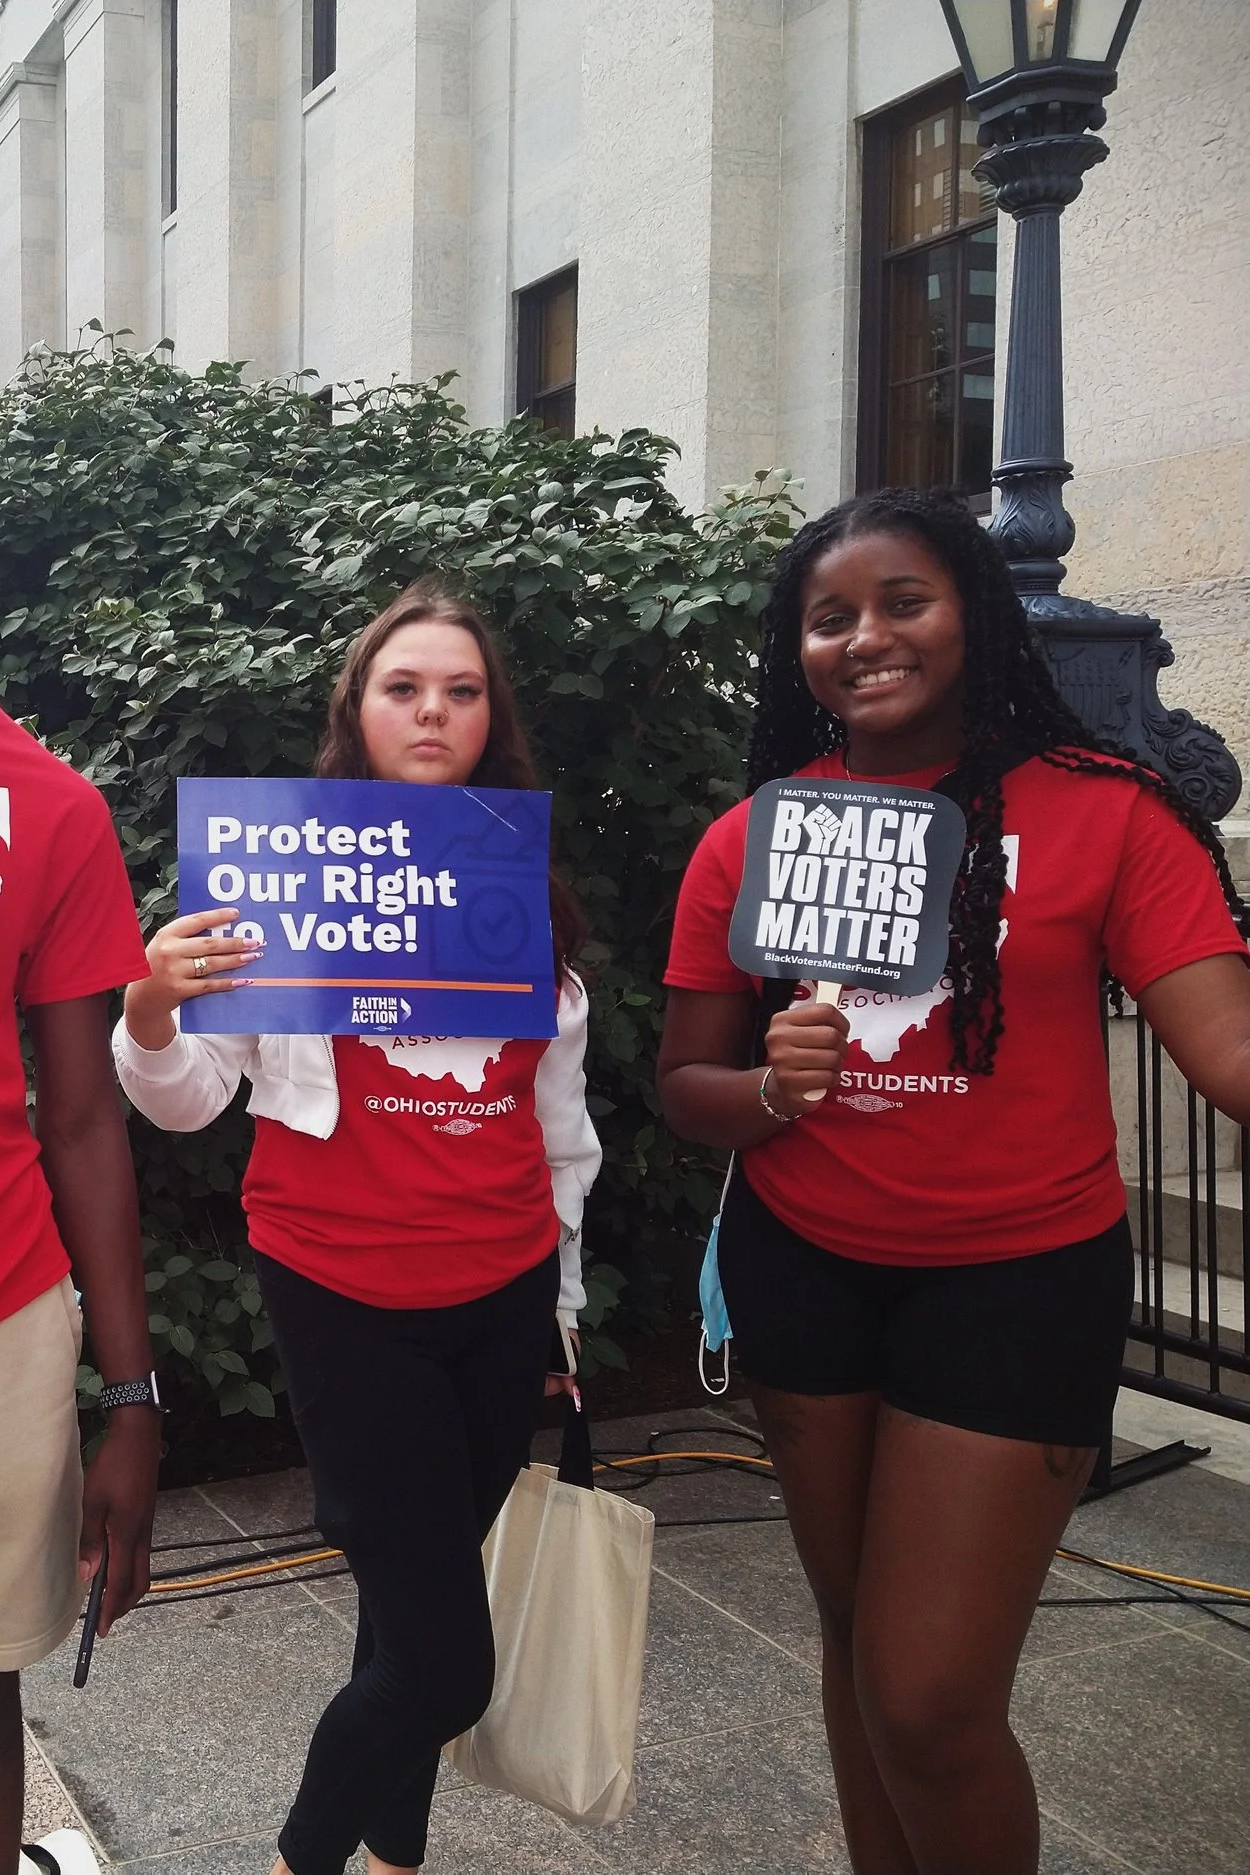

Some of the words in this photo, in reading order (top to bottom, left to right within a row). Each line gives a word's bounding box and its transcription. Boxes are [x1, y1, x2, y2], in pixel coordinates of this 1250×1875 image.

[783, 789, 820, 798] MATTER.
[822, 792, 841, 800] YOU
[843, 794, 880, 804] MATTER.
[883, 797, 897, 805] WE
[898, 799, 936, 810] MATTER.
[207, 816, 411, 857] Protect
[207, 863, 307, 903] Our
[322, 862, 458, 916] Right
[769, 852, 927, 915] VOTERS
[278, 913, 418, 953] Vote!
[755, 901, 920, 966] MATTER
[764, 953, 901, 980] BlackVotersMatterFund.org
[351, 1010, 398, 1024] ACTION
[352, 997, 387, 1010] FAITH
[388, 997, 397, 1007] IN
[839, 1071, 969, 1094] STUDENTS
[364, 1095, 516, 1117] @OHIOSTUDENTS
